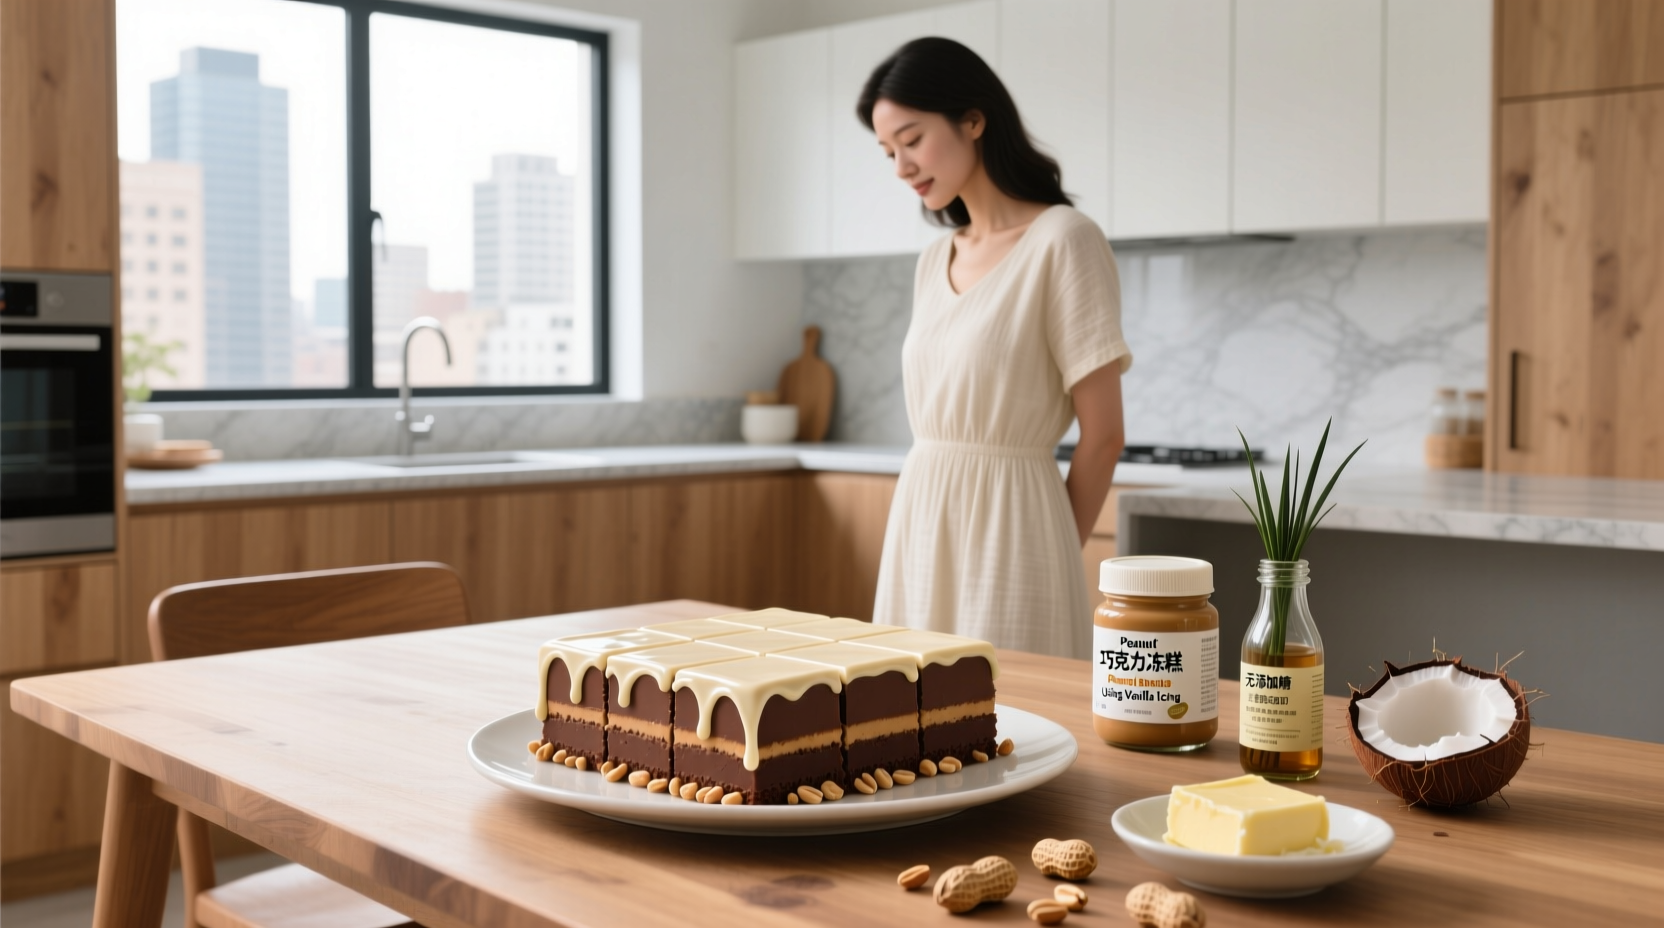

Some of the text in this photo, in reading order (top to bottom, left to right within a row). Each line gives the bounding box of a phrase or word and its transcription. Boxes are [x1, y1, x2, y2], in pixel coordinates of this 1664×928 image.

[1099, 648, 1183, 673] 巧克力冻糕
